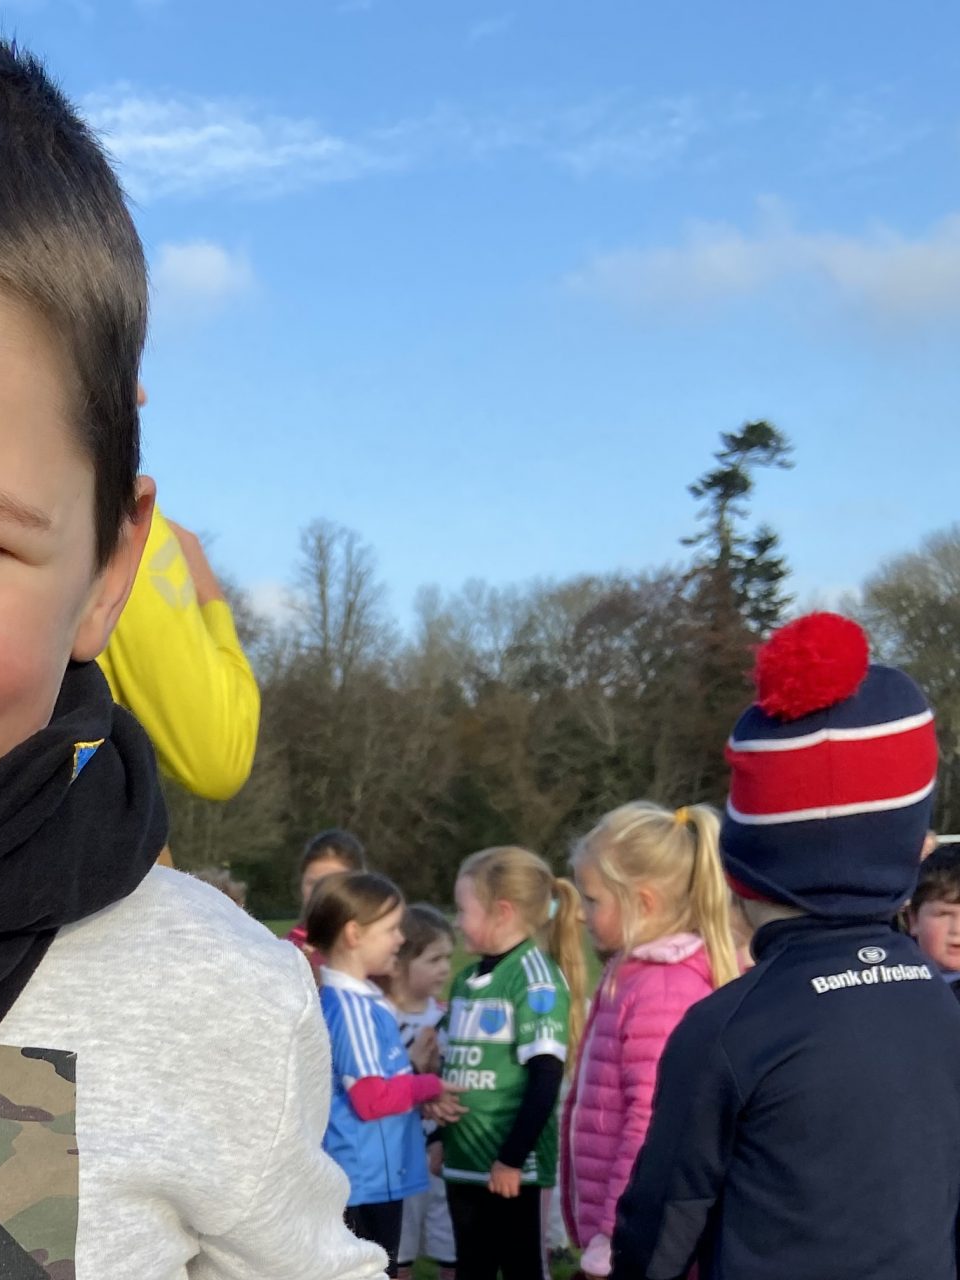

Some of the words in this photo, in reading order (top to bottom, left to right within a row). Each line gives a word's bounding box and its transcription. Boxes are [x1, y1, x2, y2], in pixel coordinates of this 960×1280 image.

[811, 969, 862, 994] Bank
[861, 965, 879, 985] of
[880, 963, 932, 983] Ireland
